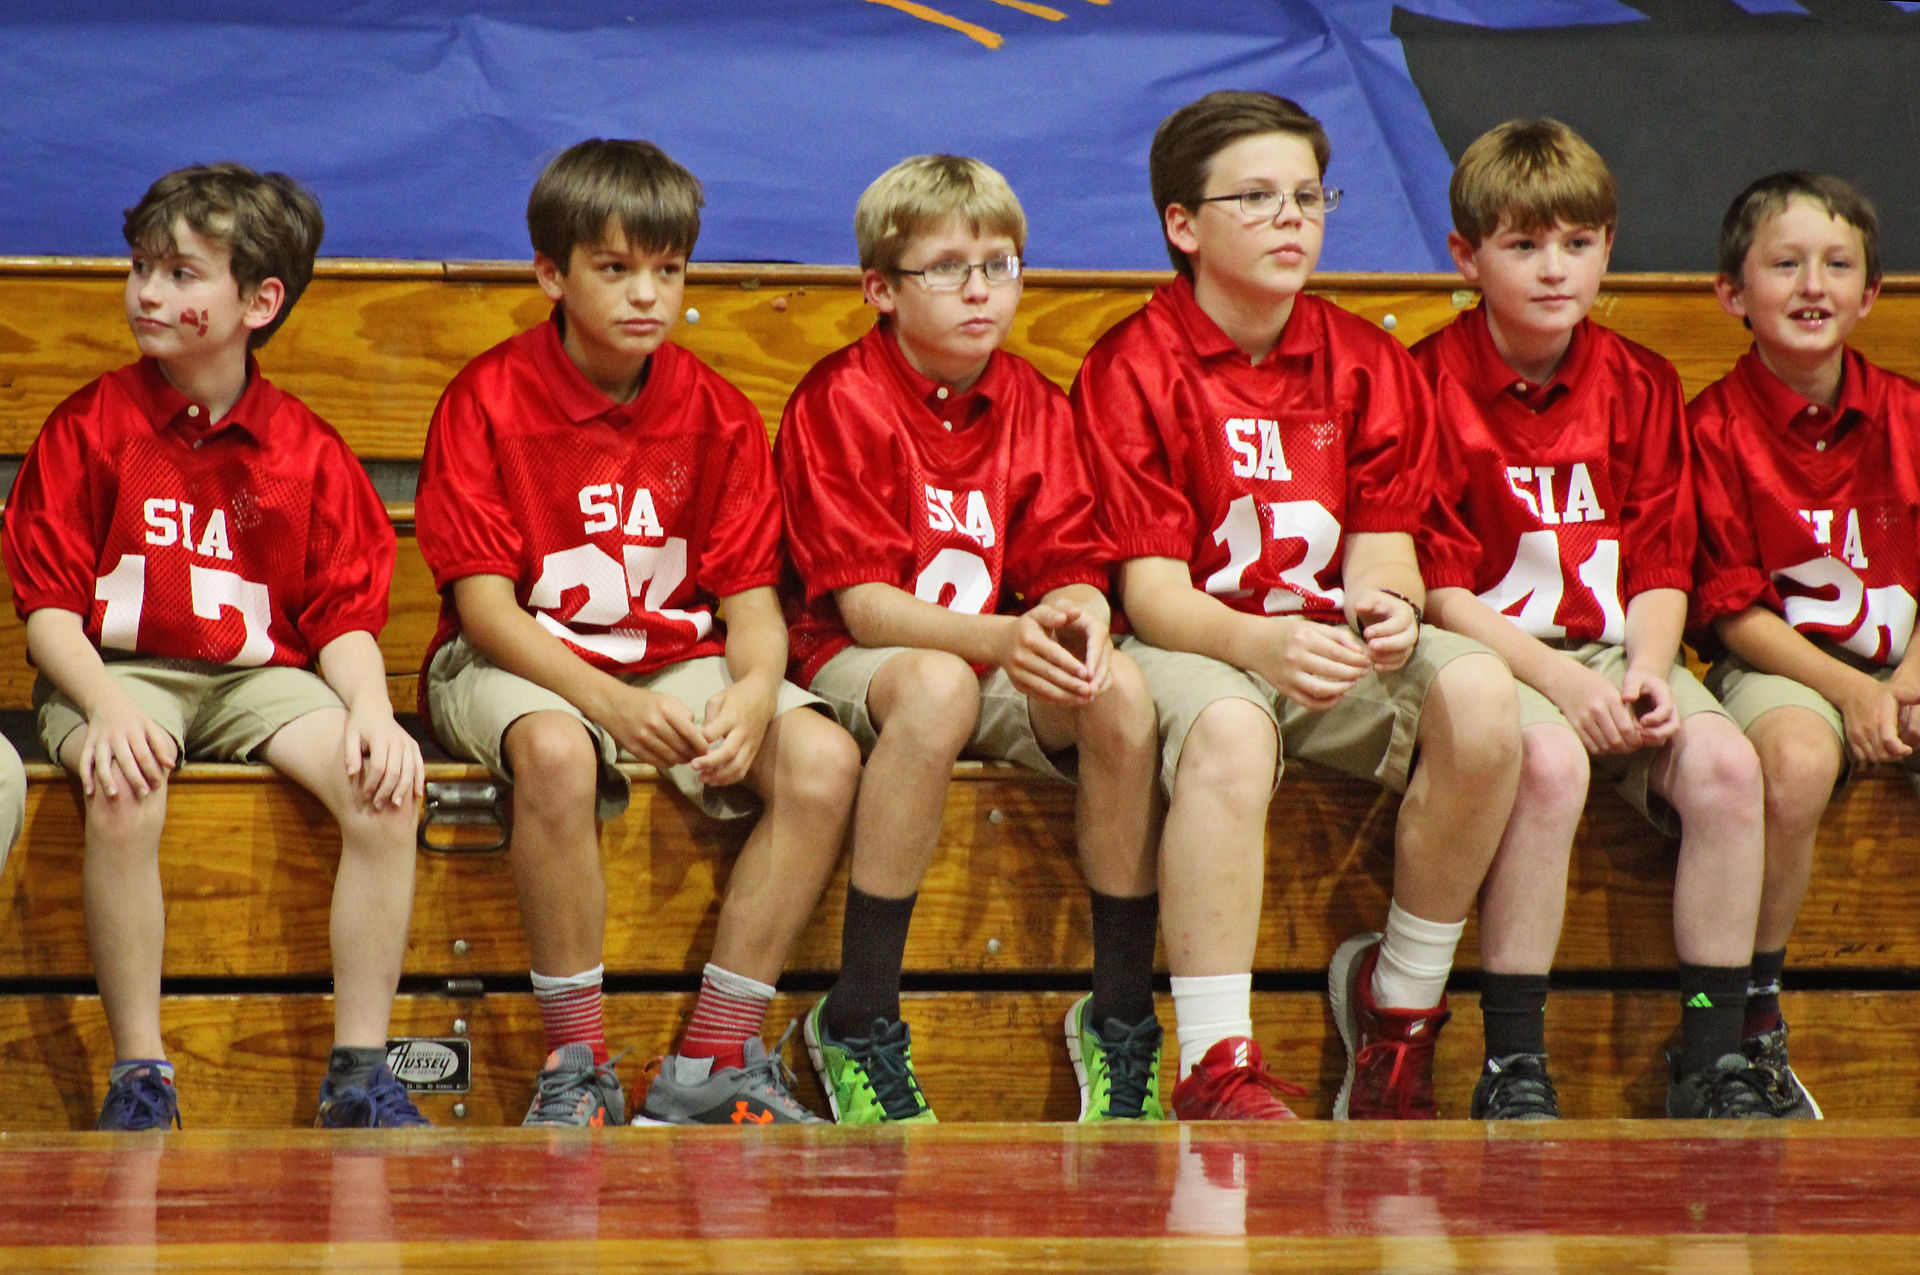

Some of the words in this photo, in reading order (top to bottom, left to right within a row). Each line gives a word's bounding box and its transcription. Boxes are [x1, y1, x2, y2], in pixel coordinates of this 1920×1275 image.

[1225, 418, 1292, 481] SIA
[143, 498, 233, 560] SIA
[1798, 508, 1868, 569] IA
